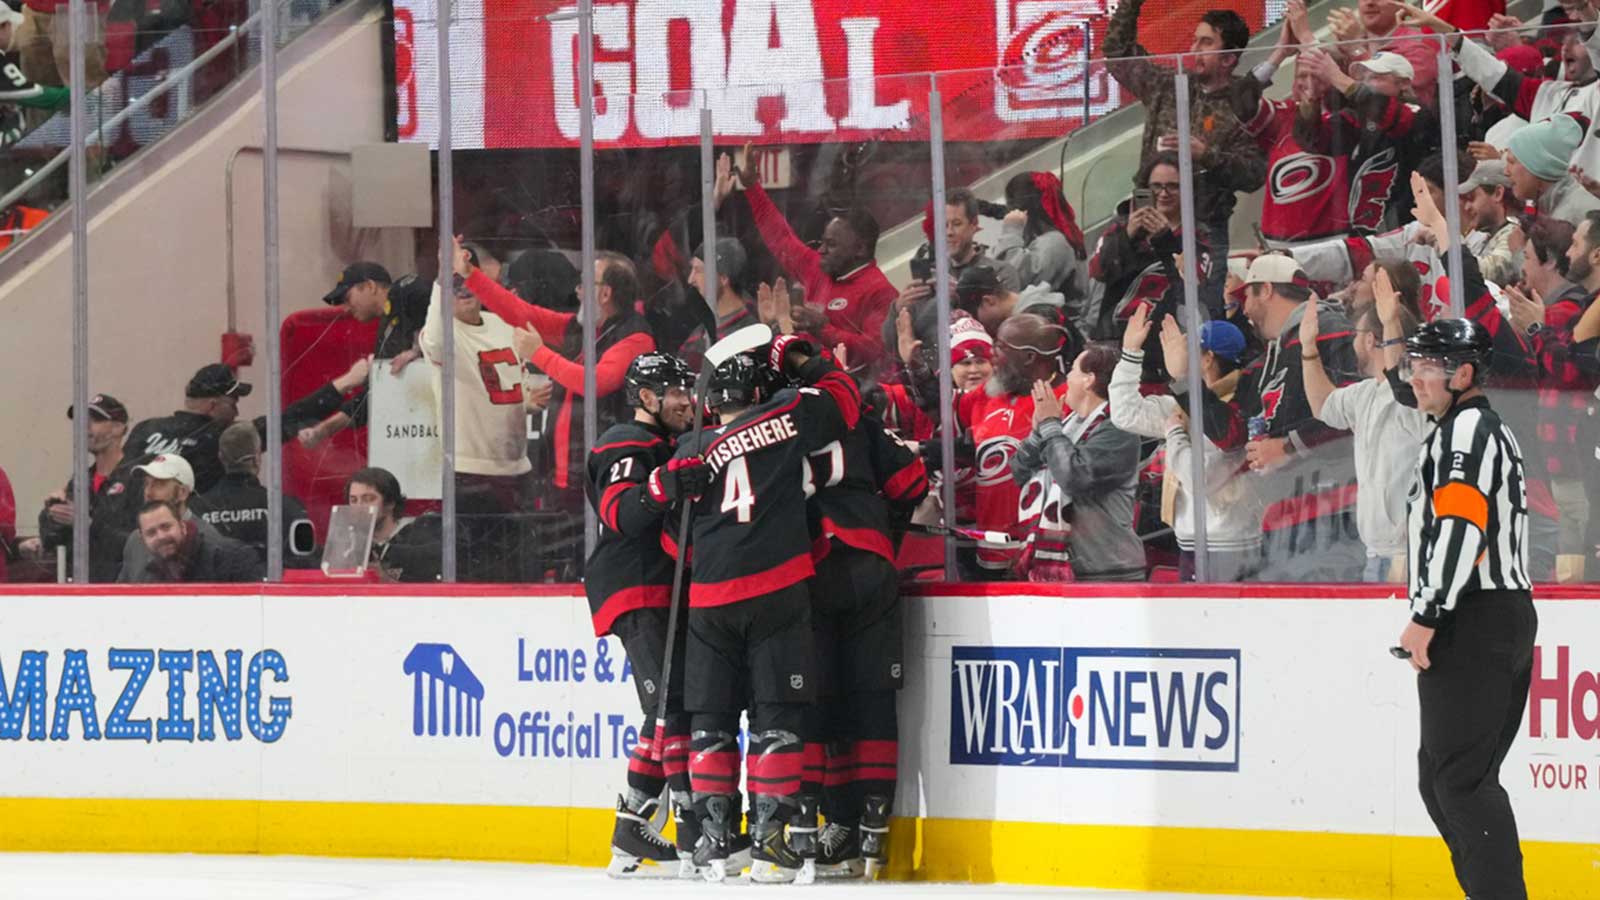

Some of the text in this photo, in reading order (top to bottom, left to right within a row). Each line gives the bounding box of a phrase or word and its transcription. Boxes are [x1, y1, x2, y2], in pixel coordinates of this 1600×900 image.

[3, 63, 27, 87] 9
[551, 0, 911, 141] GOAL
[610, 456, 633, 482] 27
[705, 413, 799, 484] TISBEHERE
[1452, 452, 1464, 468] 2
[720, 455, 755, 523] 4
[518, 638, 587, 682] Lane
[594, 636, 615, 682] &
[0, 647, 292, 744] MAZING
[954, 658, 1230, 755] WRAL NEWS
[493, 711, 602, 758] Official
[1529, 762, 1588, 790] YOUR
